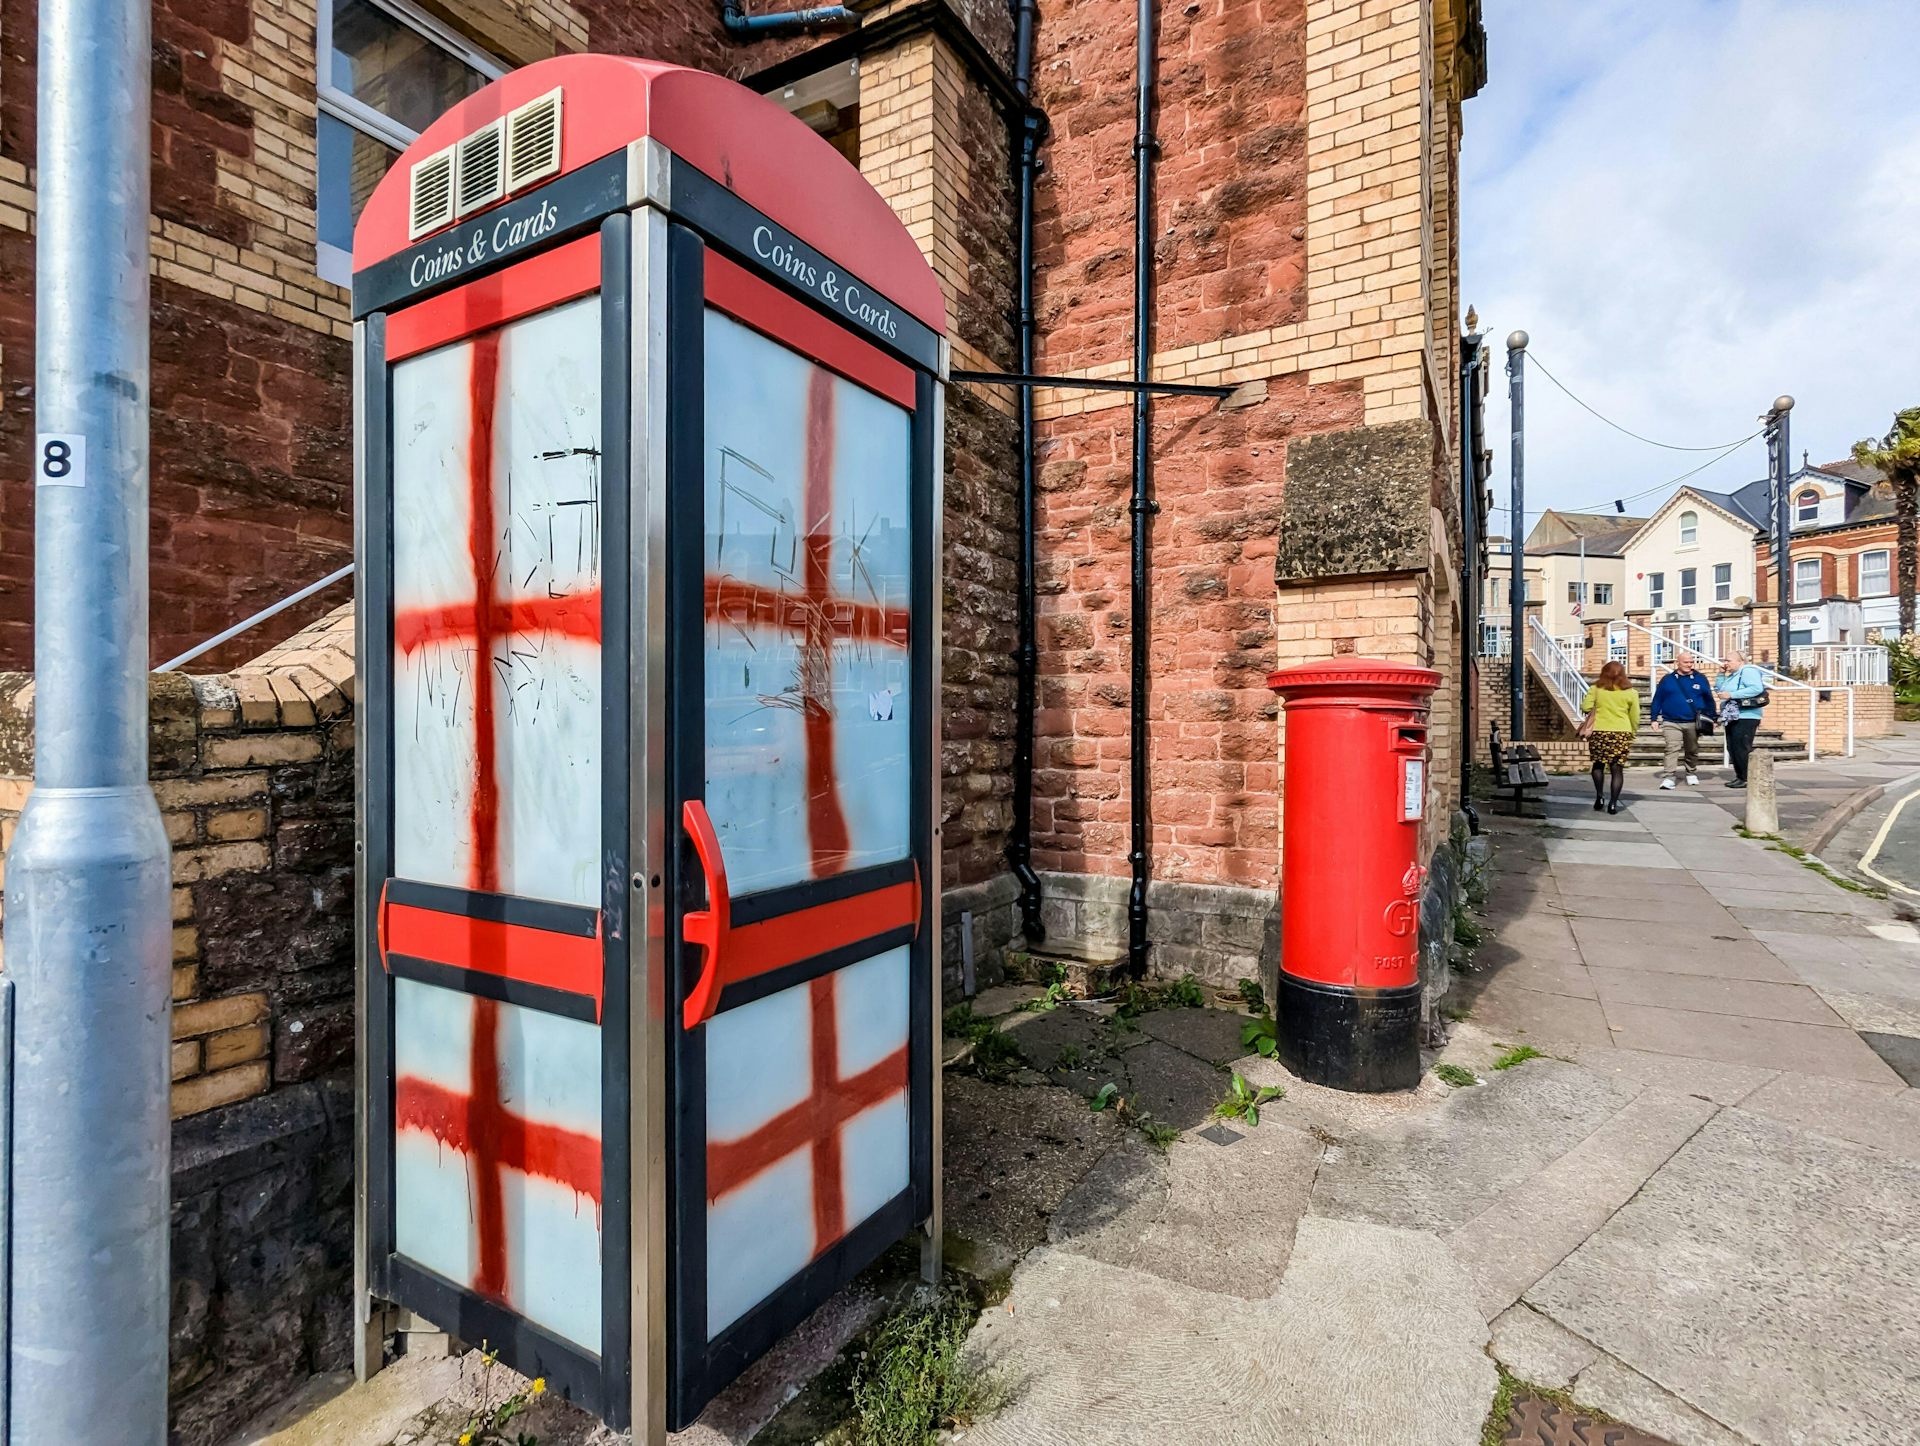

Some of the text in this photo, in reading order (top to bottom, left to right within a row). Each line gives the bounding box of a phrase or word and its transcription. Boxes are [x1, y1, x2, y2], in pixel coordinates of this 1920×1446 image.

[409, 199, 559, 288] Coins & Cards
[752, 225, 898, 339] Coins & Cards
[43, 440, 72, 478] 8
[1374, 955, 1405, 969] POST
